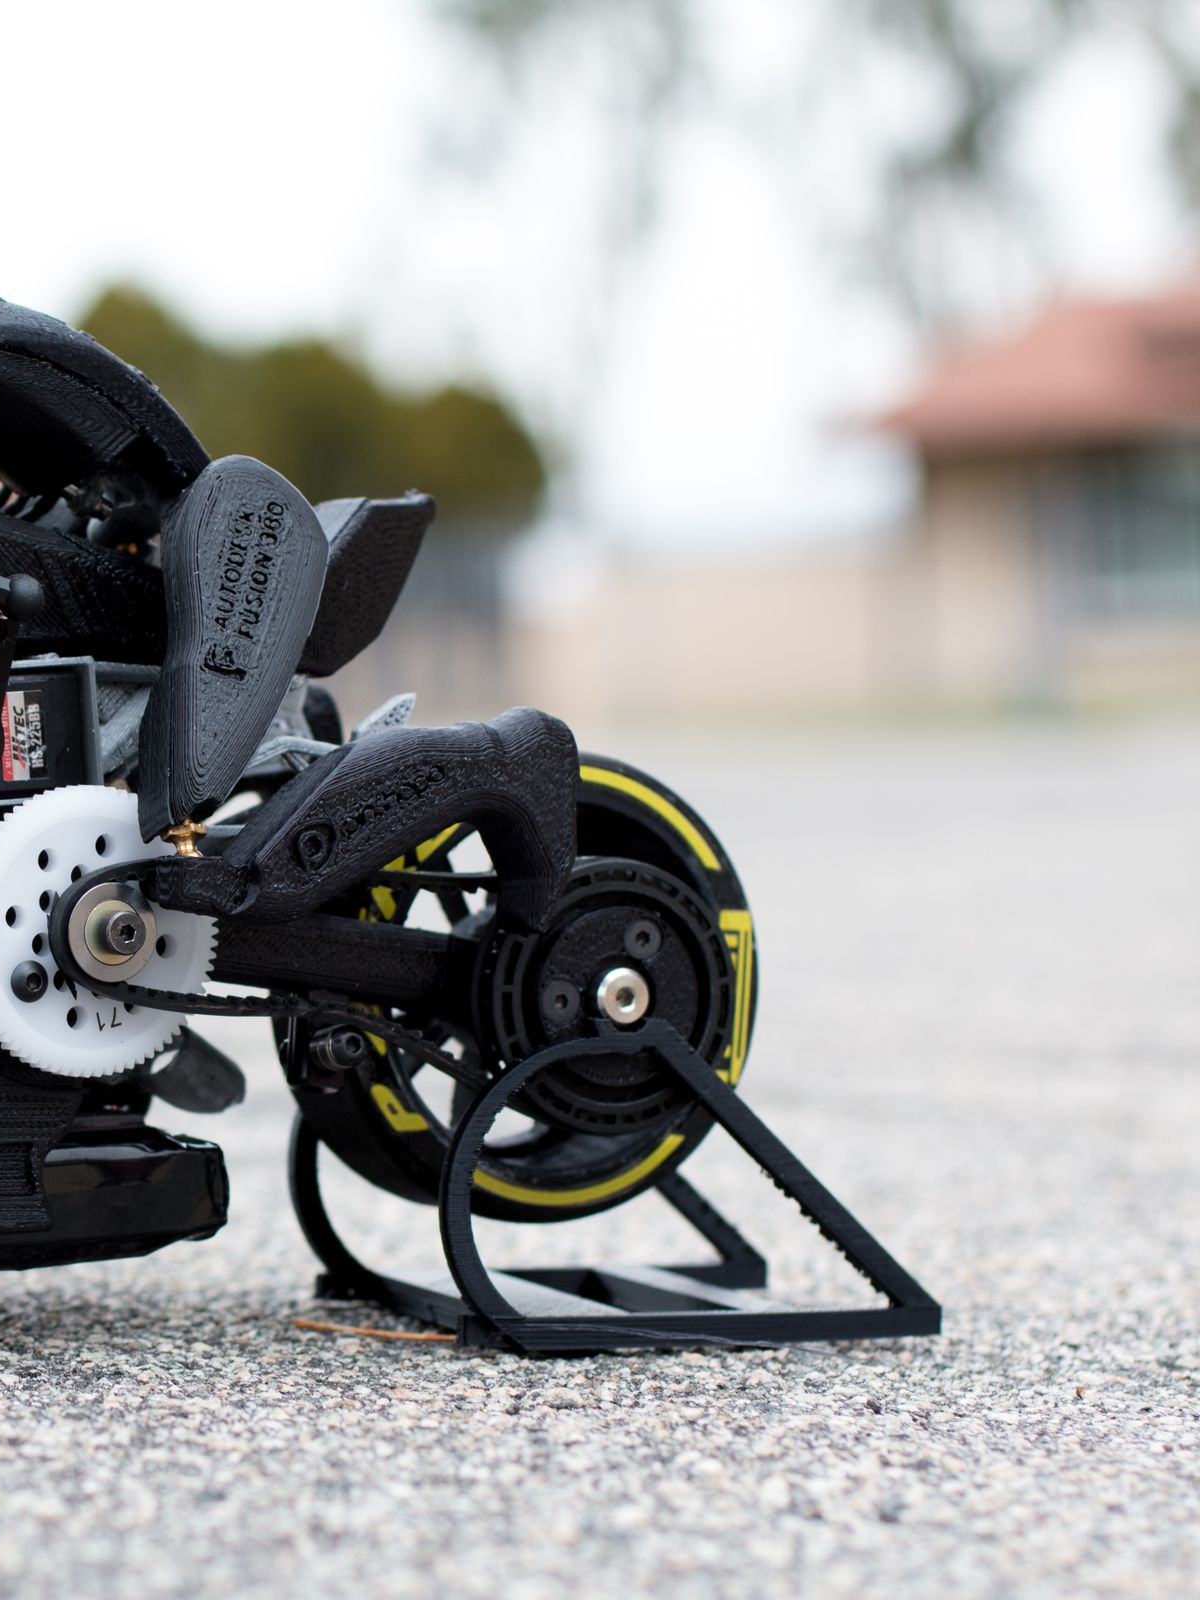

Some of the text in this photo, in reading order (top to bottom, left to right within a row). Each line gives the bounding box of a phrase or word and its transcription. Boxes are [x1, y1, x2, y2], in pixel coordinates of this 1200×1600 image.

[214, 511, 254, 632] AUTODESK
[237, 500, 286, 640] FUSION 360
[27, 703, 44, 769] HS-225BB
[96, 1006, 123, 1032] 71
